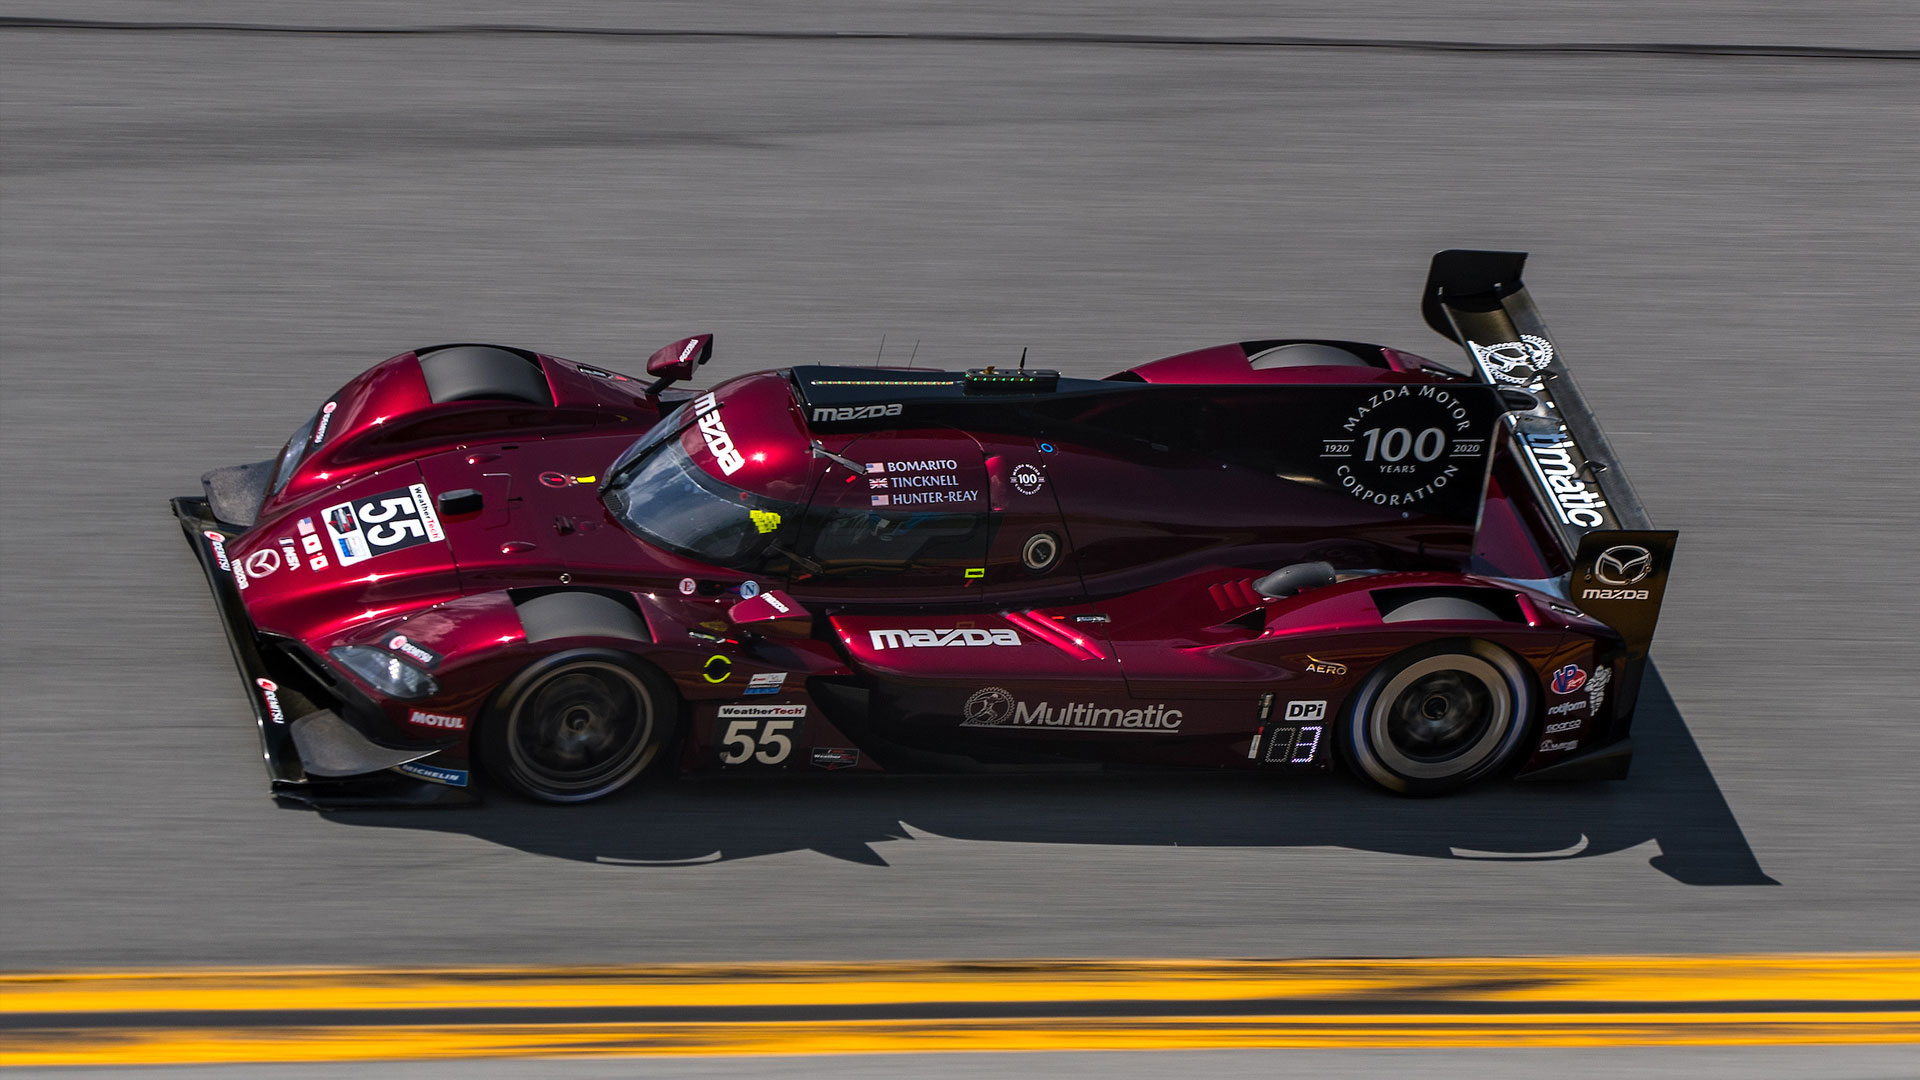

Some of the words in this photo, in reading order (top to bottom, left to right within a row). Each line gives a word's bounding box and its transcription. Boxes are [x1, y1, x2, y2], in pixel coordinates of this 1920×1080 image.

[1343, 385, 1410, 432] MAZDA
[1418, 385, 1471, 432] MOTOR
[1325, 444, 1350, 453] 1920
[1362, 427, 1446, 462] 100
[1453, 444, 1481, 453] 2020
[887, 459, 958, 473] BOMARITO
[1379, 464, 1416, 474] YEARS
[890, 475, 959, 489] TINCKNELL
[1018, 473, 1037, 484] 100
[1336, 464, 1460, 506] CORPORATION
[893, 490, 979, 505] HUNTER-REAY
[414, 486, 441, 539] WeatherTech
[358, 497, 425, 546] 55
[1305, 663, 1348, 676] AERO
[1553, 664, 1578, 692] VP
[722, 707, 804, 715] WeatherTech
[1013, 701, 1184, 729] Multimatic
[1288, 703, 1324, 717] DPi
[410, 711, 465, 728] MOTUL
[719, 720, 795, 764] 55
[402, 764, 460, 781] MICHELIN
